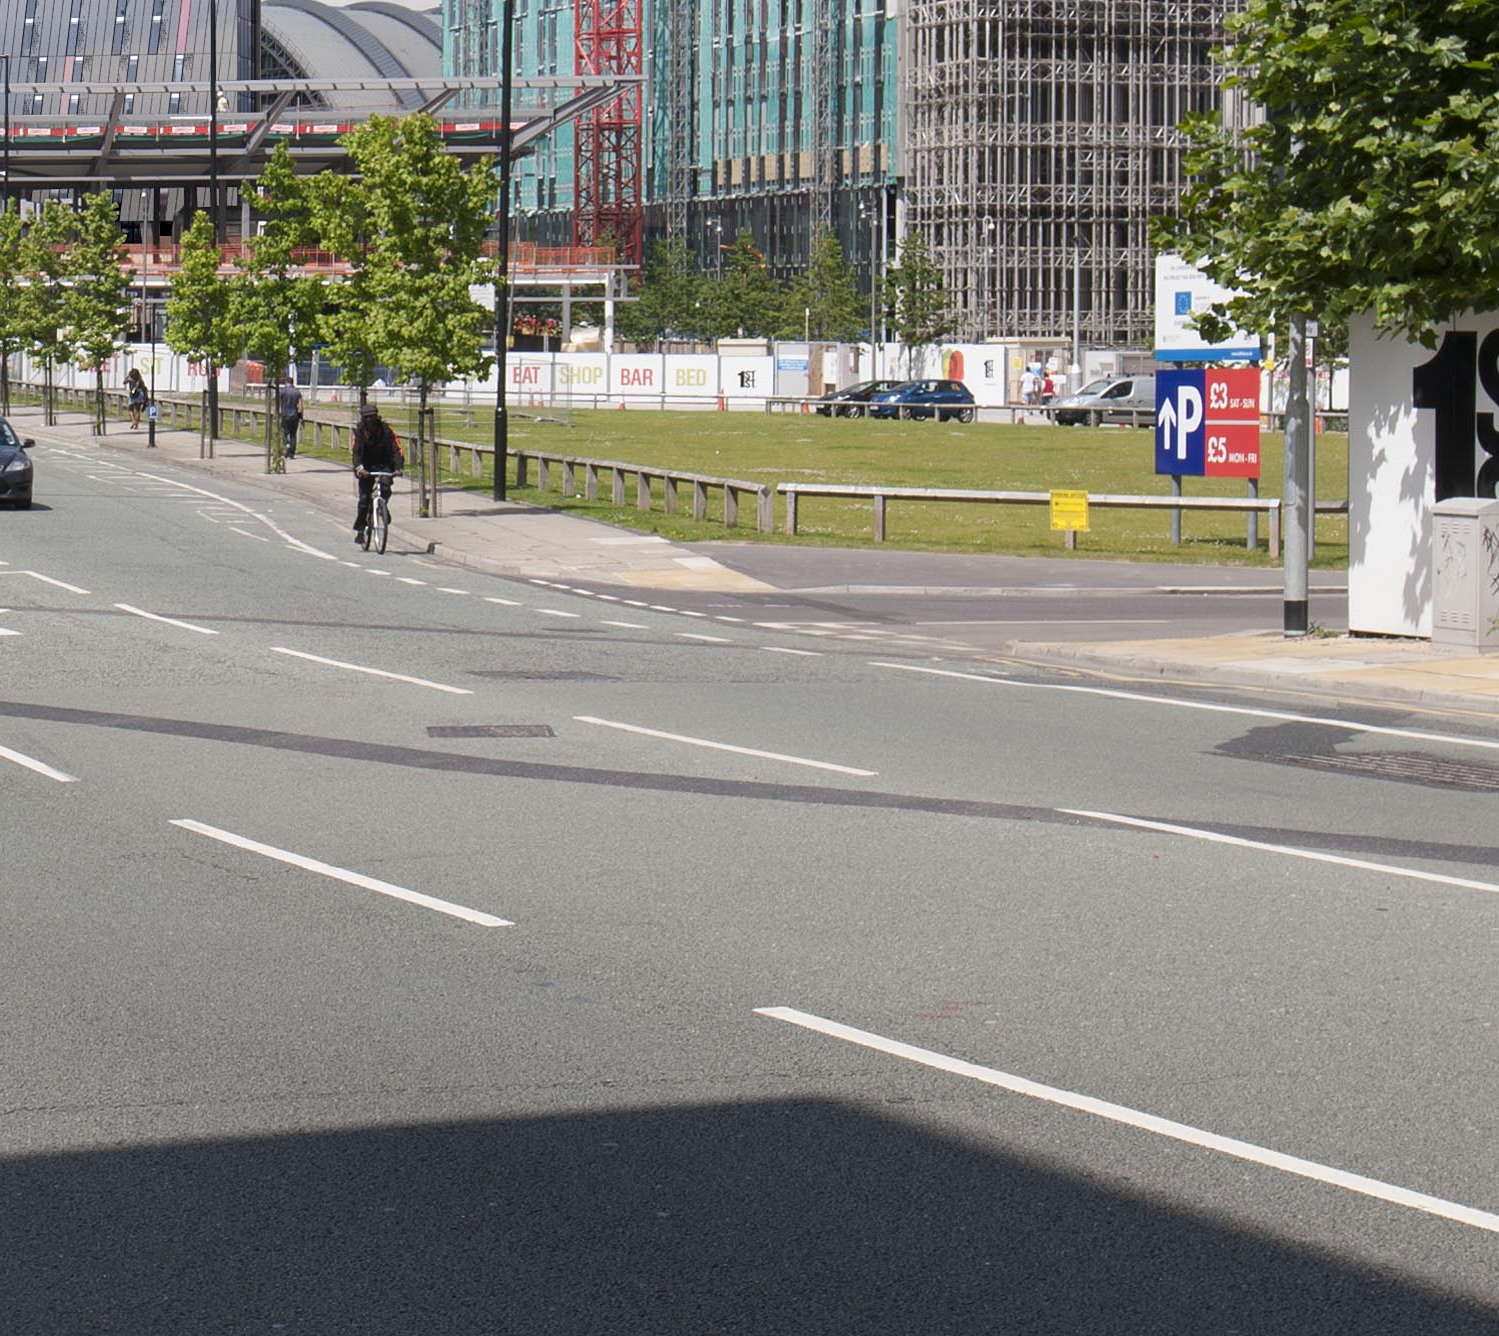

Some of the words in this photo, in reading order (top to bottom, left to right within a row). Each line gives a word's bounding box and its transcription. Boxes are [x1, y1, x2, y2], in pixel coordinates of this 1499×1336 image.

[512, 366, 540, 384] EAT
[560, 366, 603, 384] SHOP
[620, 368, 653, 386] BAR
[676, 368, 707, 386] BED
[1210, 382, 1228, 409] £3
[1177, 385, 1203, 460] P
[1207, 436, 1227, 463] £5
